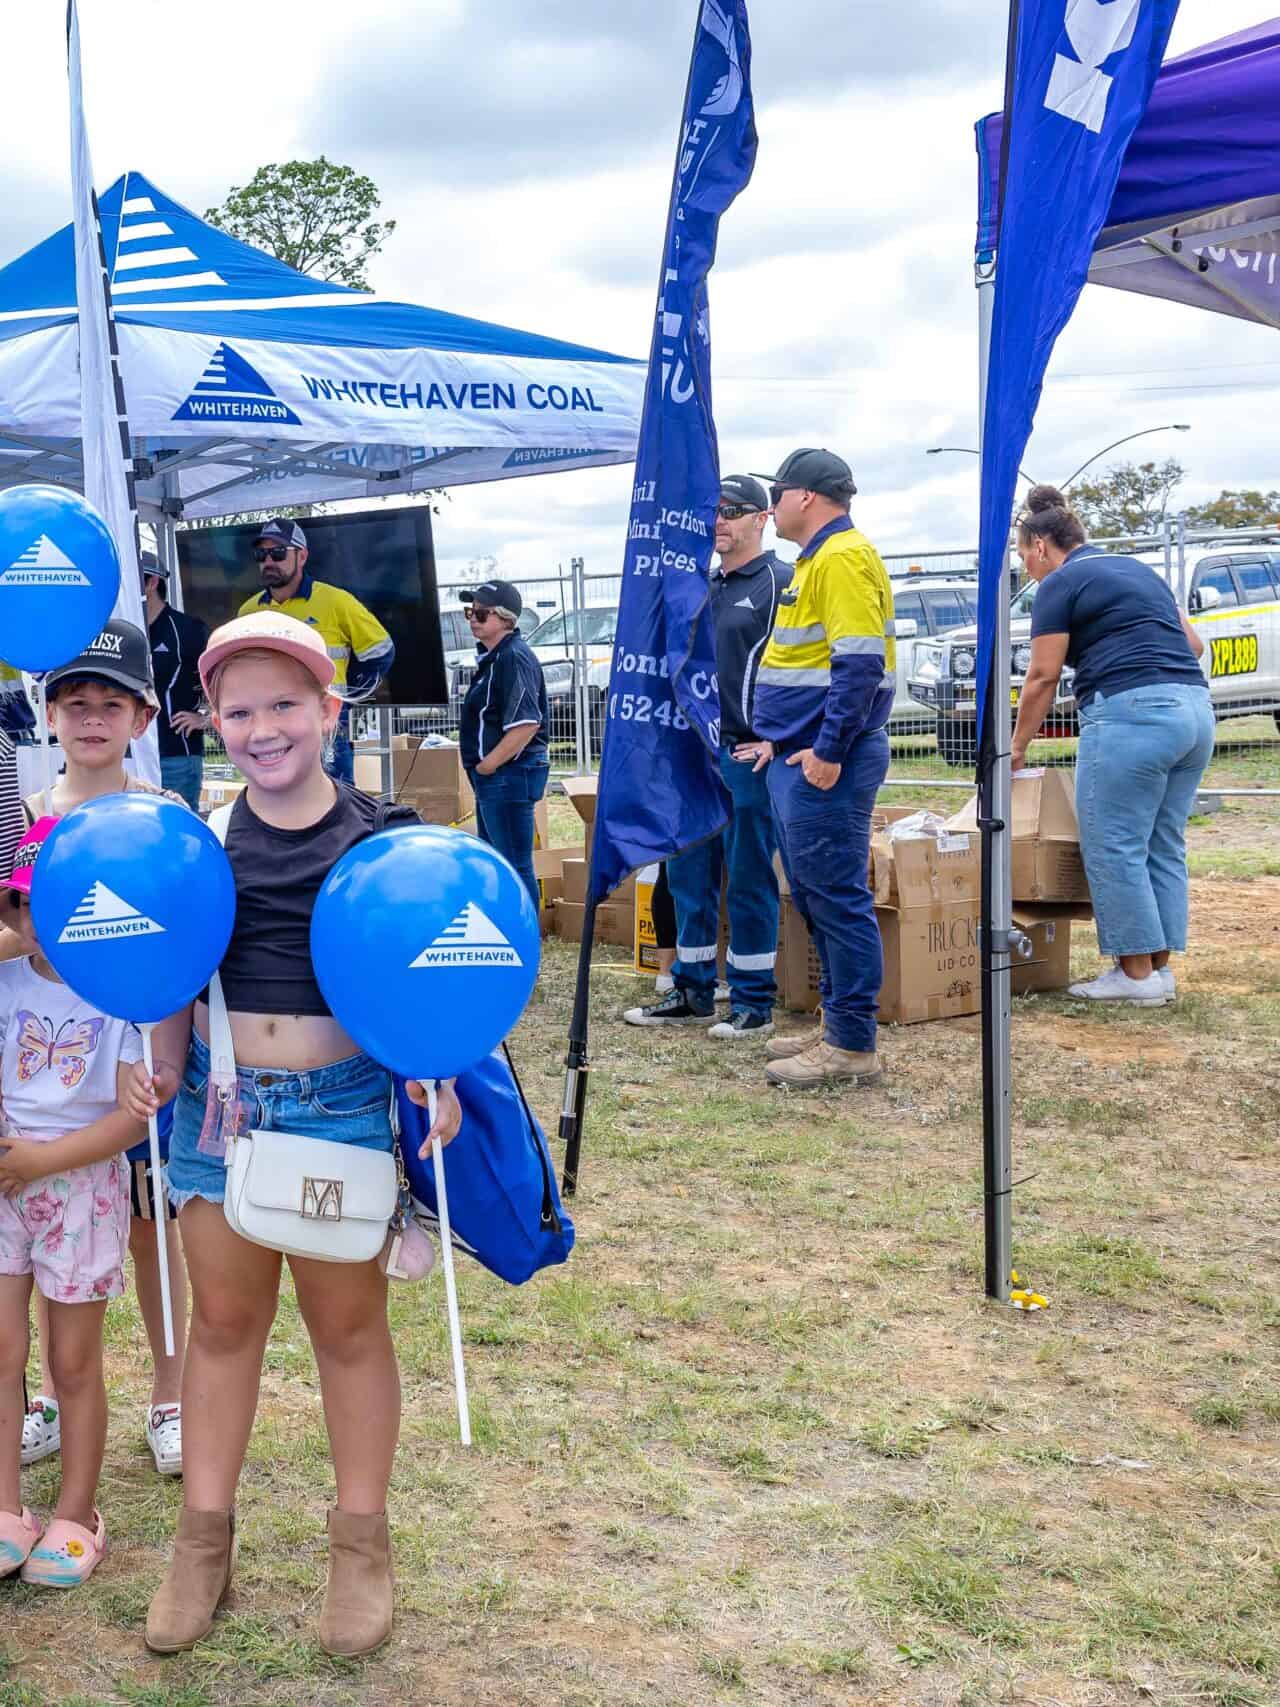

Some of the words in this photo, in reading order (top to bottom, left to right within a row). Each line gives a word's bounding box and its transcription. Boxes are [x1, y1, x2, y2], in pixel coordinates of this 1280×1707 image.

[299, 373, 516, 410] WHITEHAVEN
[526, 383, 604, 412] COAL
[189, 401, 289, 419] WHITEHAVEN
[5, 573, 81, 583] WHITEHAVEN
[1211, 635, 1257, 677] XPL888
[66, 921, 150, 939] WHITEHAVEN
[927, 916, 978, 953] TRUCK
[425, 951, 515, 962] WHITEHAVEN
